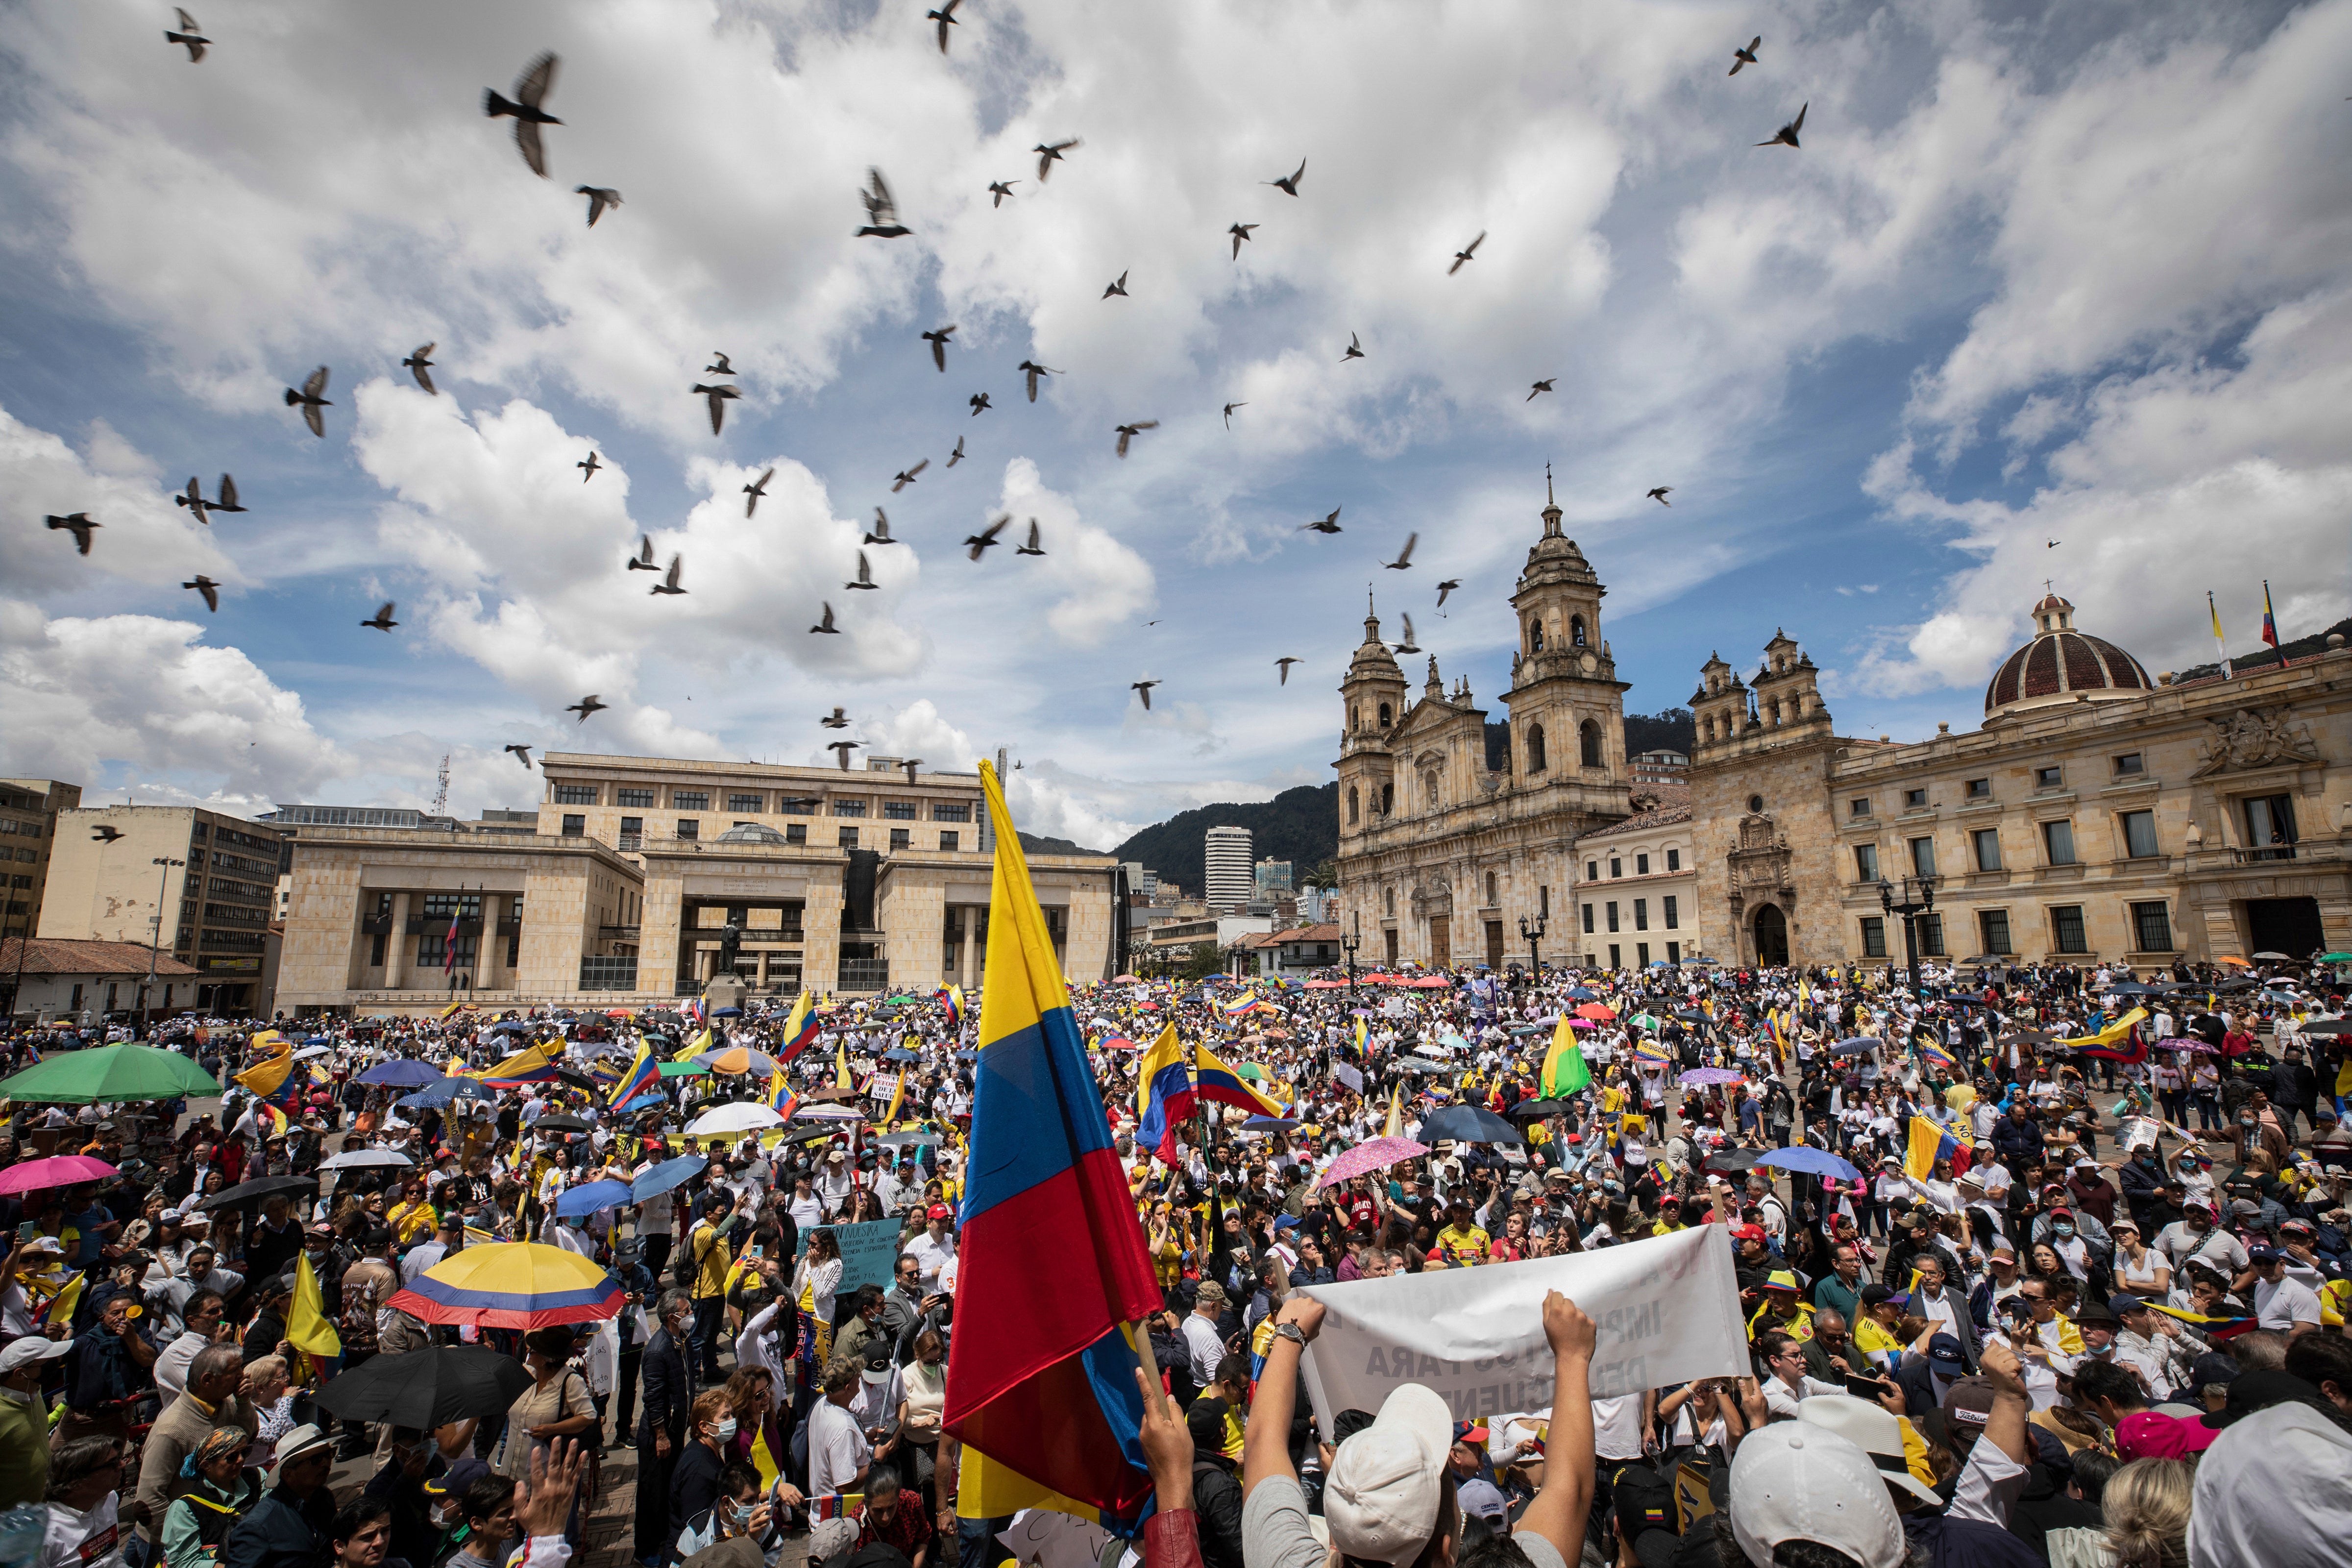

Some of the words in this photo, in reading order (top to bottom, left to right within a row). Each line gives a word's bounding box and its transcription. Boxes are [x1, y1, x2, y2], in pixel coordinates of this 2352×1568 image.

[1648, 1044, 1661, 1053] DIGO
[447, 1107, 455, 1123] DIGO
[451, 1124, 458, 1136] NO
[1958, 1125, 1970, 1137] NO
[845, 1225, 878, 1240] NUESTRA
[947, 1277, 955, 1289] 3
[1958, 1410, 1988, 1423] Titleist
